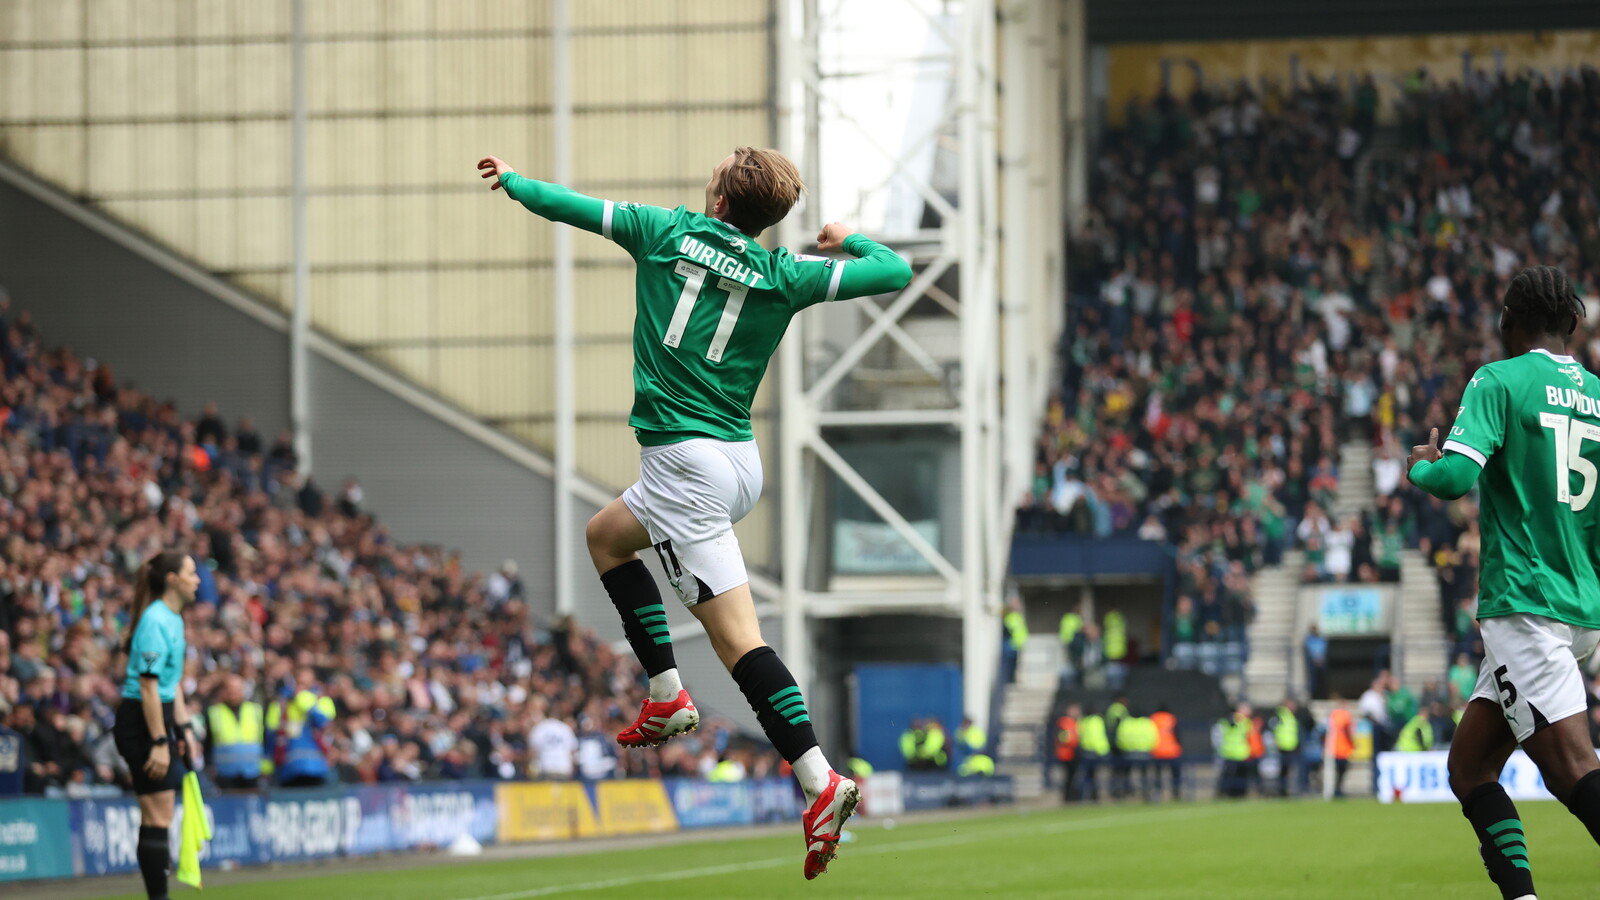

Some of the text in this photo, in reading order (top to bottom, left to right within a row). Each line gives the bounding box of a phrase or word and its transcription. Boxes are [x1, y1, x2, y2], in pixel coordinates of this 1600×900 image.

[679, 235, 764, 287] WRIGHT
[662, 259, 749, 363] 11
[1545, 385, 1600, 418] BUNDU
[1539, 412, 1600, 512] 15
[653, 539, 682, 580] 11
[1494, 664, 1517, 709] 5
